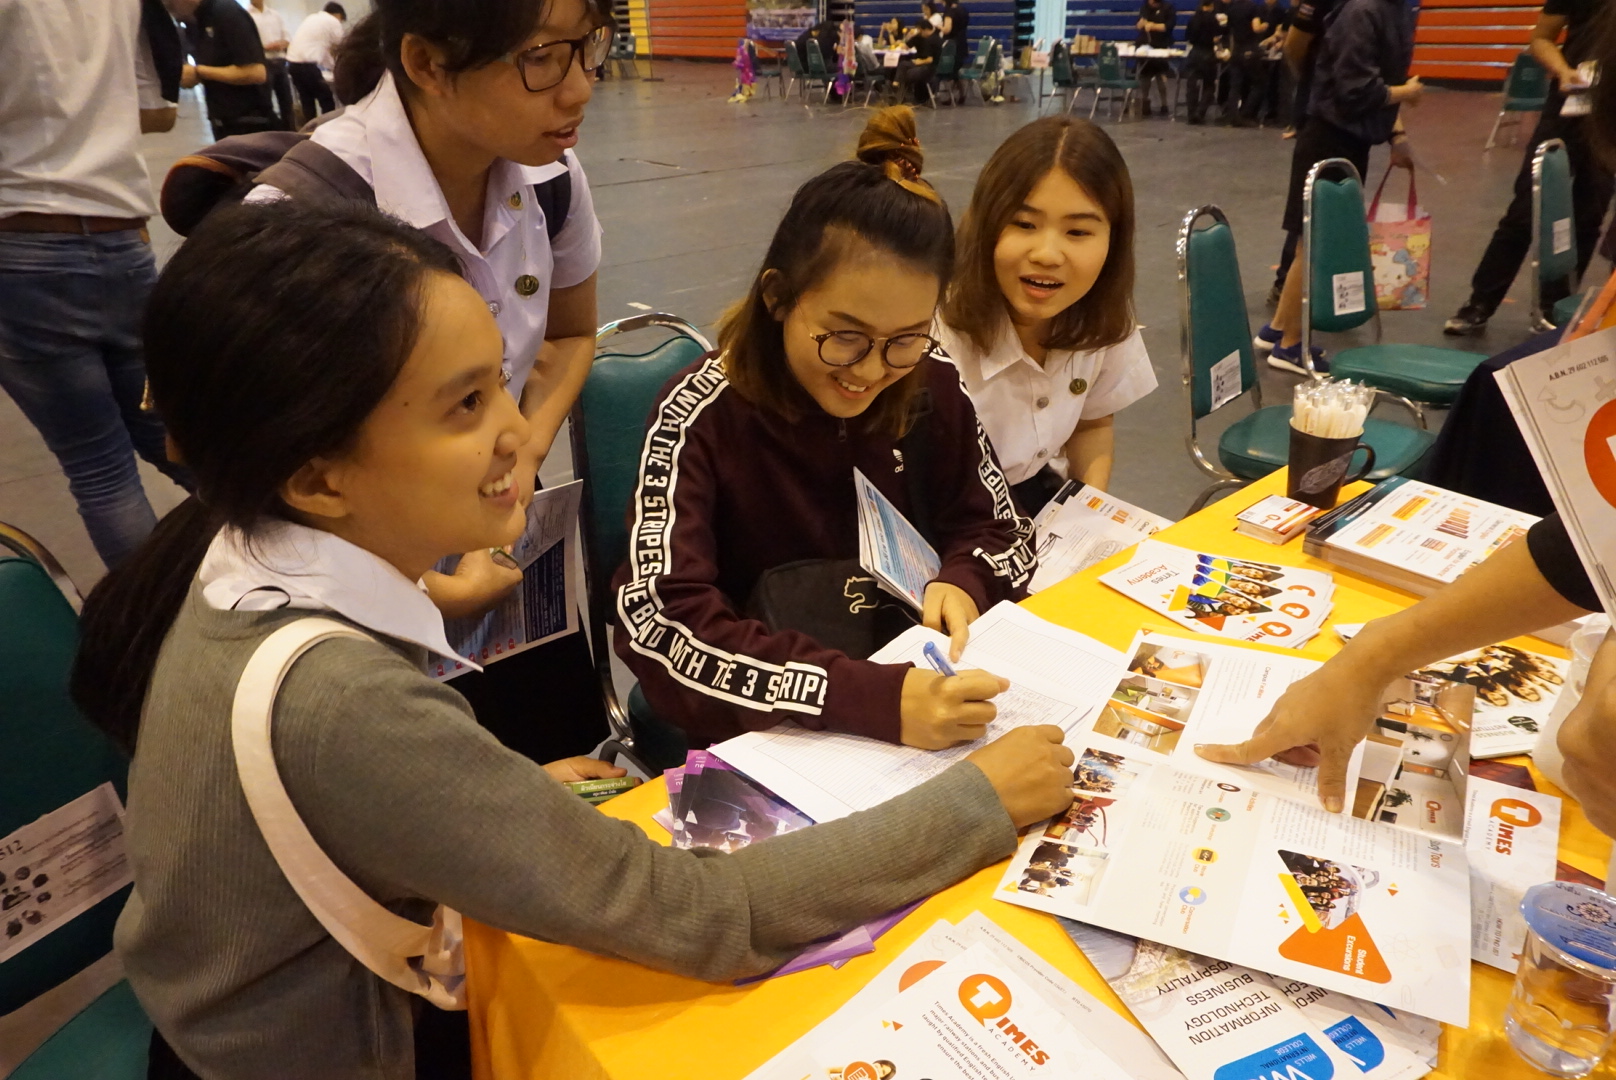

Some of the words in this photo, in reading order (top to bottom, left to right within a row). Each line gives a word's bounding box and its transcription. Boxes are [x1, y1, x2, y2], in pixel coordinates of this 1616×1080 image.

[692, 363, 727, 394] ND
[647, 435, 676, 470] THE
[644, 474, 668, 488] 3
[980, 461, 1012, 520] STRIPE
[638, 496, 668, 576] STRIPES
[1126, 564, 1168, 586] Academy
[624, 578, 649, 606] HE
[711, 660, 737, 690] TE
[742, 669, 759, 697] 3
[1485, 820, 1495, 851] ACADEMY
[1342, 935, 1356, 972] Excursions
[1355, 949, 1367, 975] Student
[1186, 973, 1254, 1006] BUSINESS
[1292, 987, 1328, 1009] INFO
[964, 977, 1050, 1066] TIMES
[1184, 990, 1271, 1031] TECHNOLOGY
[1188, 1002, 1283, 1045] INFORMATION
[922, 1014, 938, 1033] taught
[936, 1028, 944, 1038] by
[942, 1035, 965, 1059] qualified
[963, 1056, 982, 1076] English
[930, 1009, 944, 1024] major
[943, 1023, 961, 1042] railway
[960, 1040, 981, 1062] stations
[980, 1060, 990, 1071] and
[935, 1001, 949, 1016] Times
[948, 1015, 969, 1038] Academy
[978, 1044, 992, 1060] fresh
[991, 1057, 1010, 1077] English
[1328, 1023, 1353, 1039] COLLEG
[1345, 1036, 1367, 1050] WELLS
[937, 1043, 955, 1060] ensure
[954, 1058, 963, 1070] the
[988, 1028, 1036, 1072] ACADEMY
[1260, 1047, 1309, 1069] INTERNATIONAL
[1274, 1040, 1303, 1056] COLLEGE
[1294, 1053, 1317, 1066] WELLS
